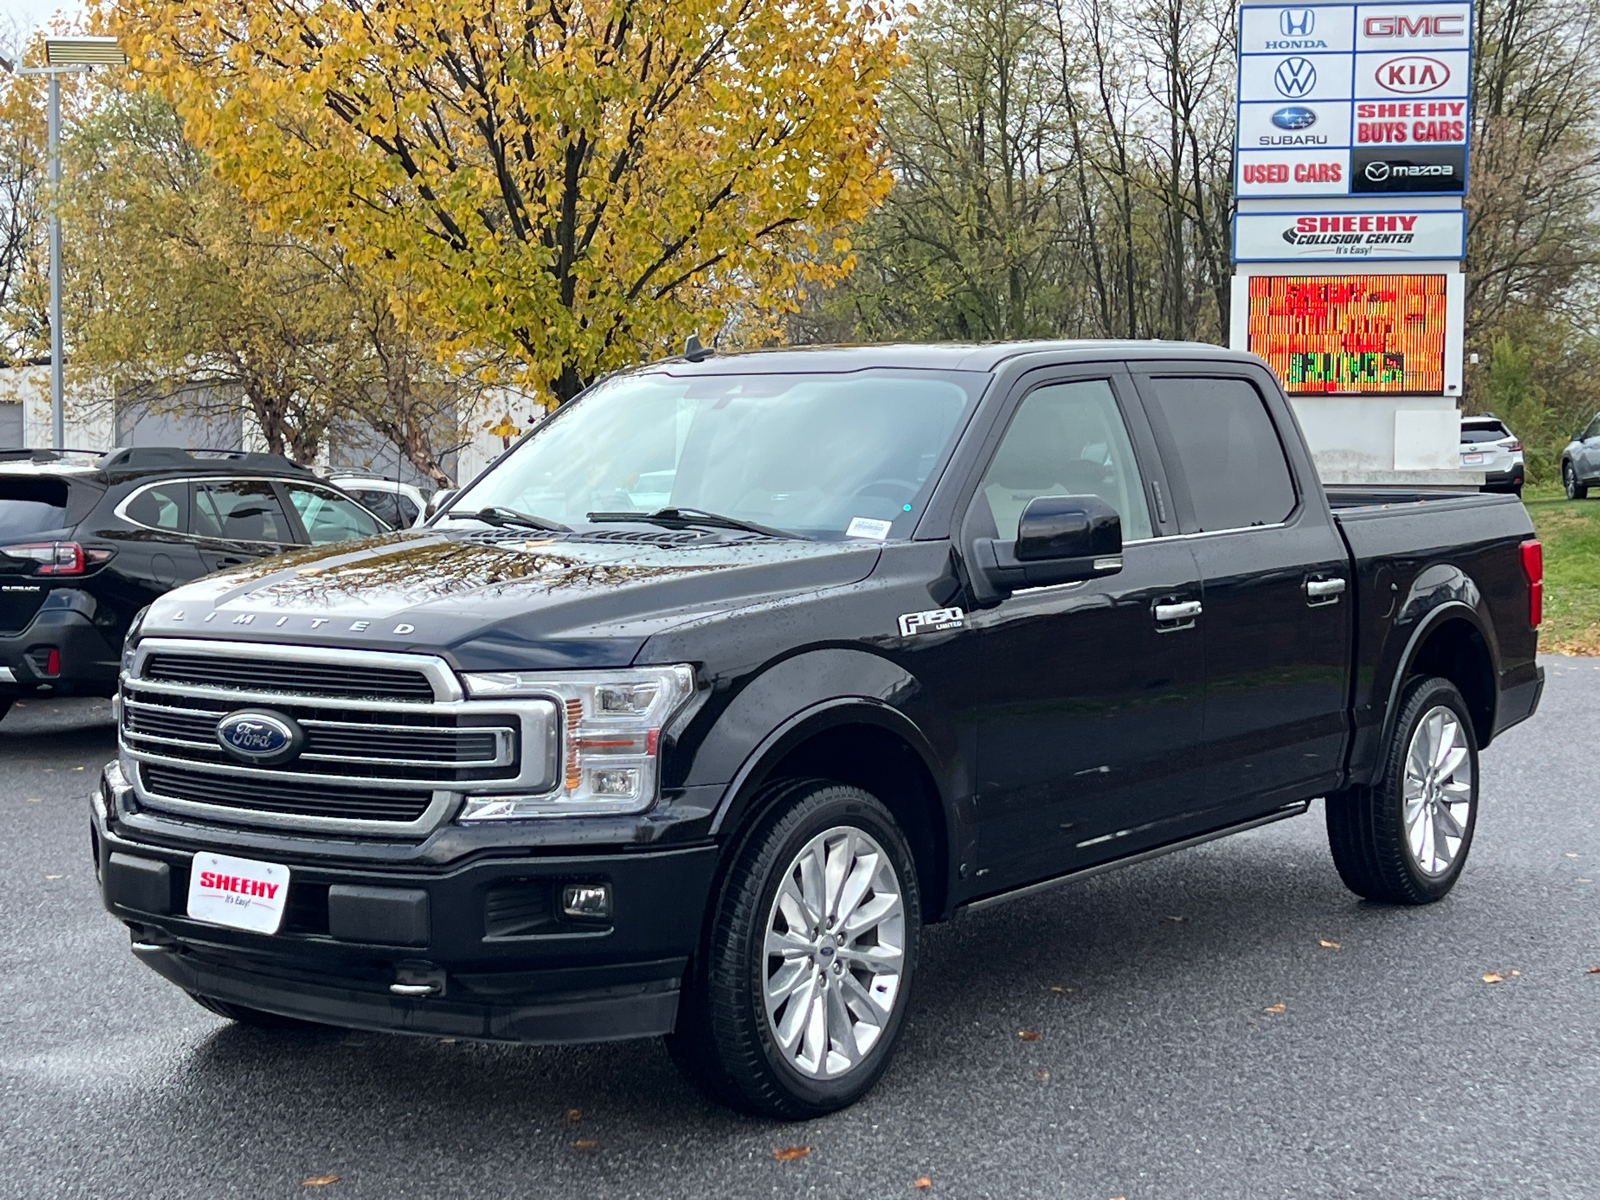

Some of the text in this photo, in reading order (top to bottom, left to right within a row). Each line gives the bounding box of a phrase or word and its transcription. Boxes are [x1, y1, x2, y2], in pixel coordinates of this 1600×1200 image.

[1364, 15, 1464, 38] GMC
[1265, 40, 1328, 49] HONDA
[1388, 65, 1437, 85] KIA
[1357, 102, 1465, 118] SHEEHY
[1259, 135, 1328, 145] SUBARU
[1357, 120, 1465, 143] BUYS CARS
[1243, 163, 1342, 183] USED CARS
[1392, 165, 1453, 177] mazda
[1296, 215, 1418, 233] SHEEHY
[1296, 233, 1414, 245] COLLISION CENTER
[1335, 245, 1373, 256] It's Easy!
[172, 610, 415, 635] LIMITED
[232, 722, 271, 748] Ford
[200, 870, 279, 899] SHEEHY
[225, 894, 251, 908] It's Easy!
